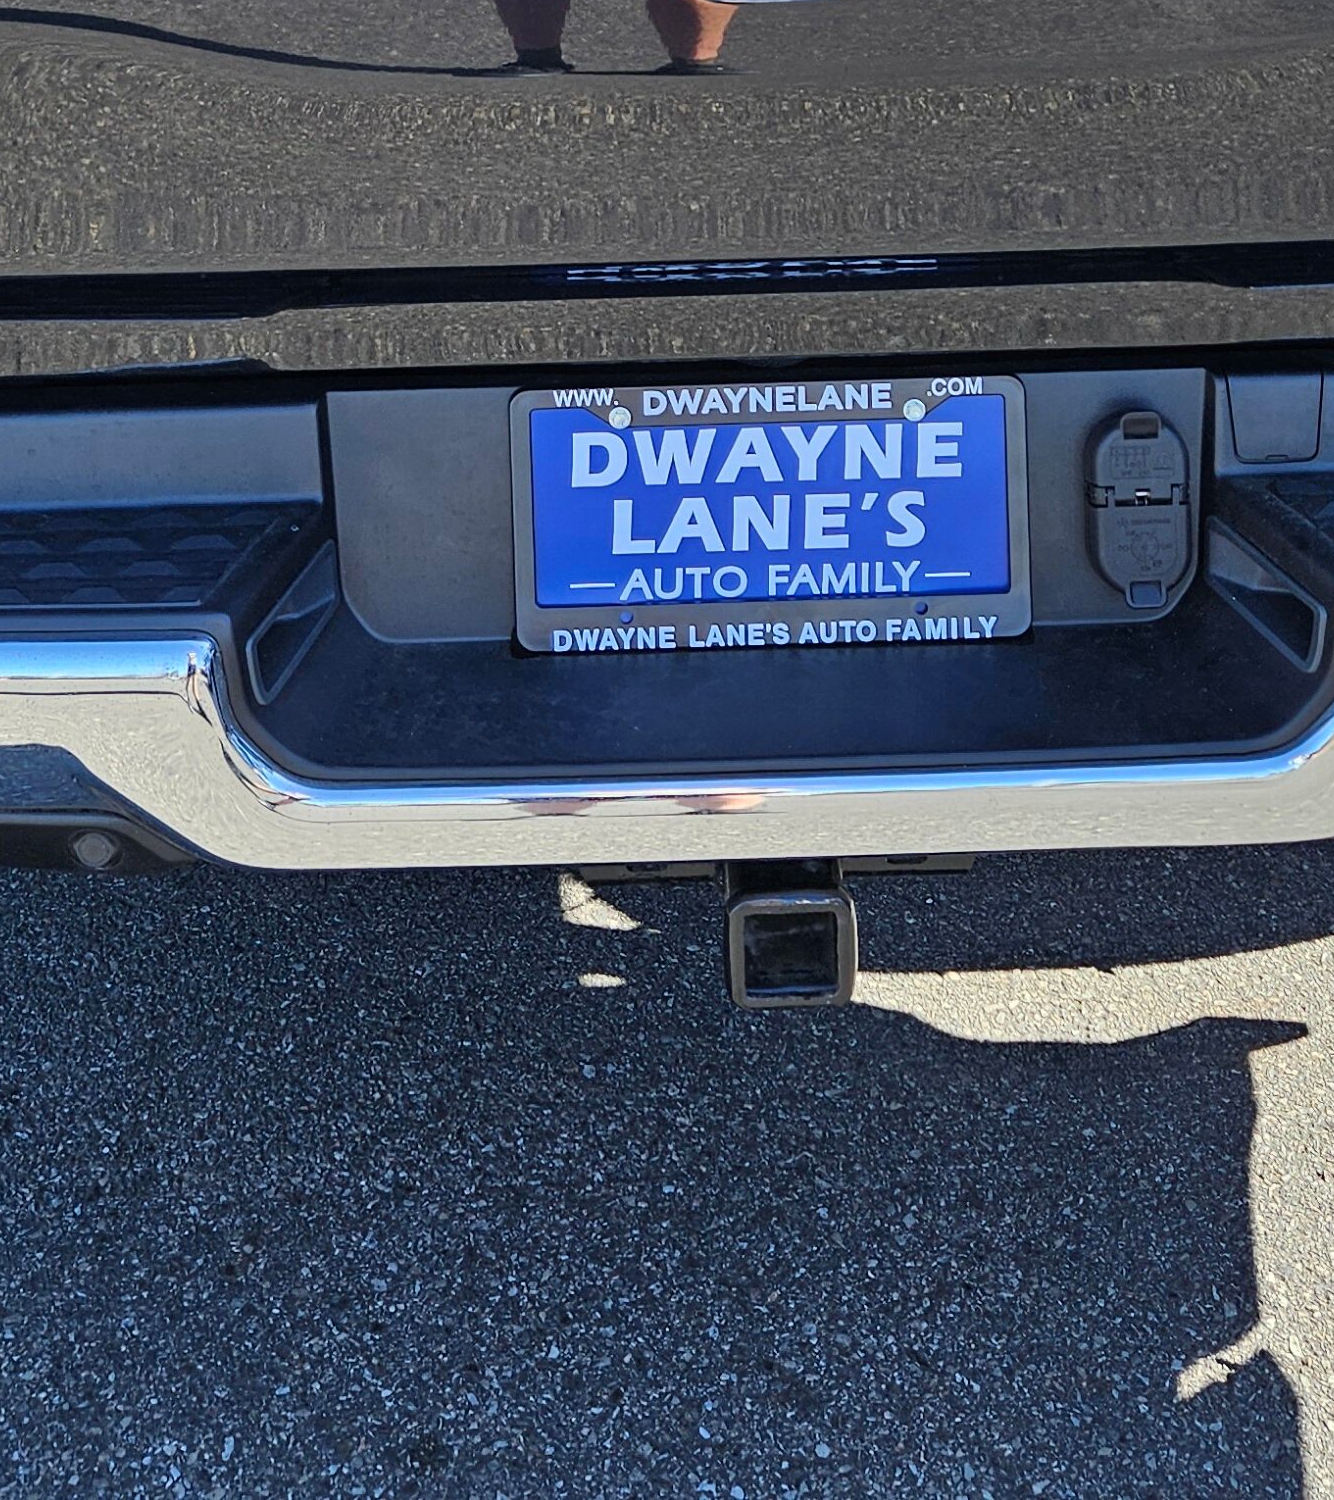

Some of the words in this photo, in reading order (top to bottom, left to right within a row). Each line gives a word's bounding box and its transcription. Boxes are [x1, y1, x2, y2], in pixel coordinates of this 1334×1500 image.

[643, 383, 892, 417] DWAYNELANE
[570, 421, 963, 488] DWAYNE
[611, 490, 926, 555] LANE'S
[619, 566, 748, 601] AUTO
[768, 560, 921, 597] FAMILY
[552, 625, 677, 653] DWAYNE
[688, 621, 791, 649] LANE'S
[798, 619, 878, 645] AUTO
[886, 615, 998, 640] FAMILY
